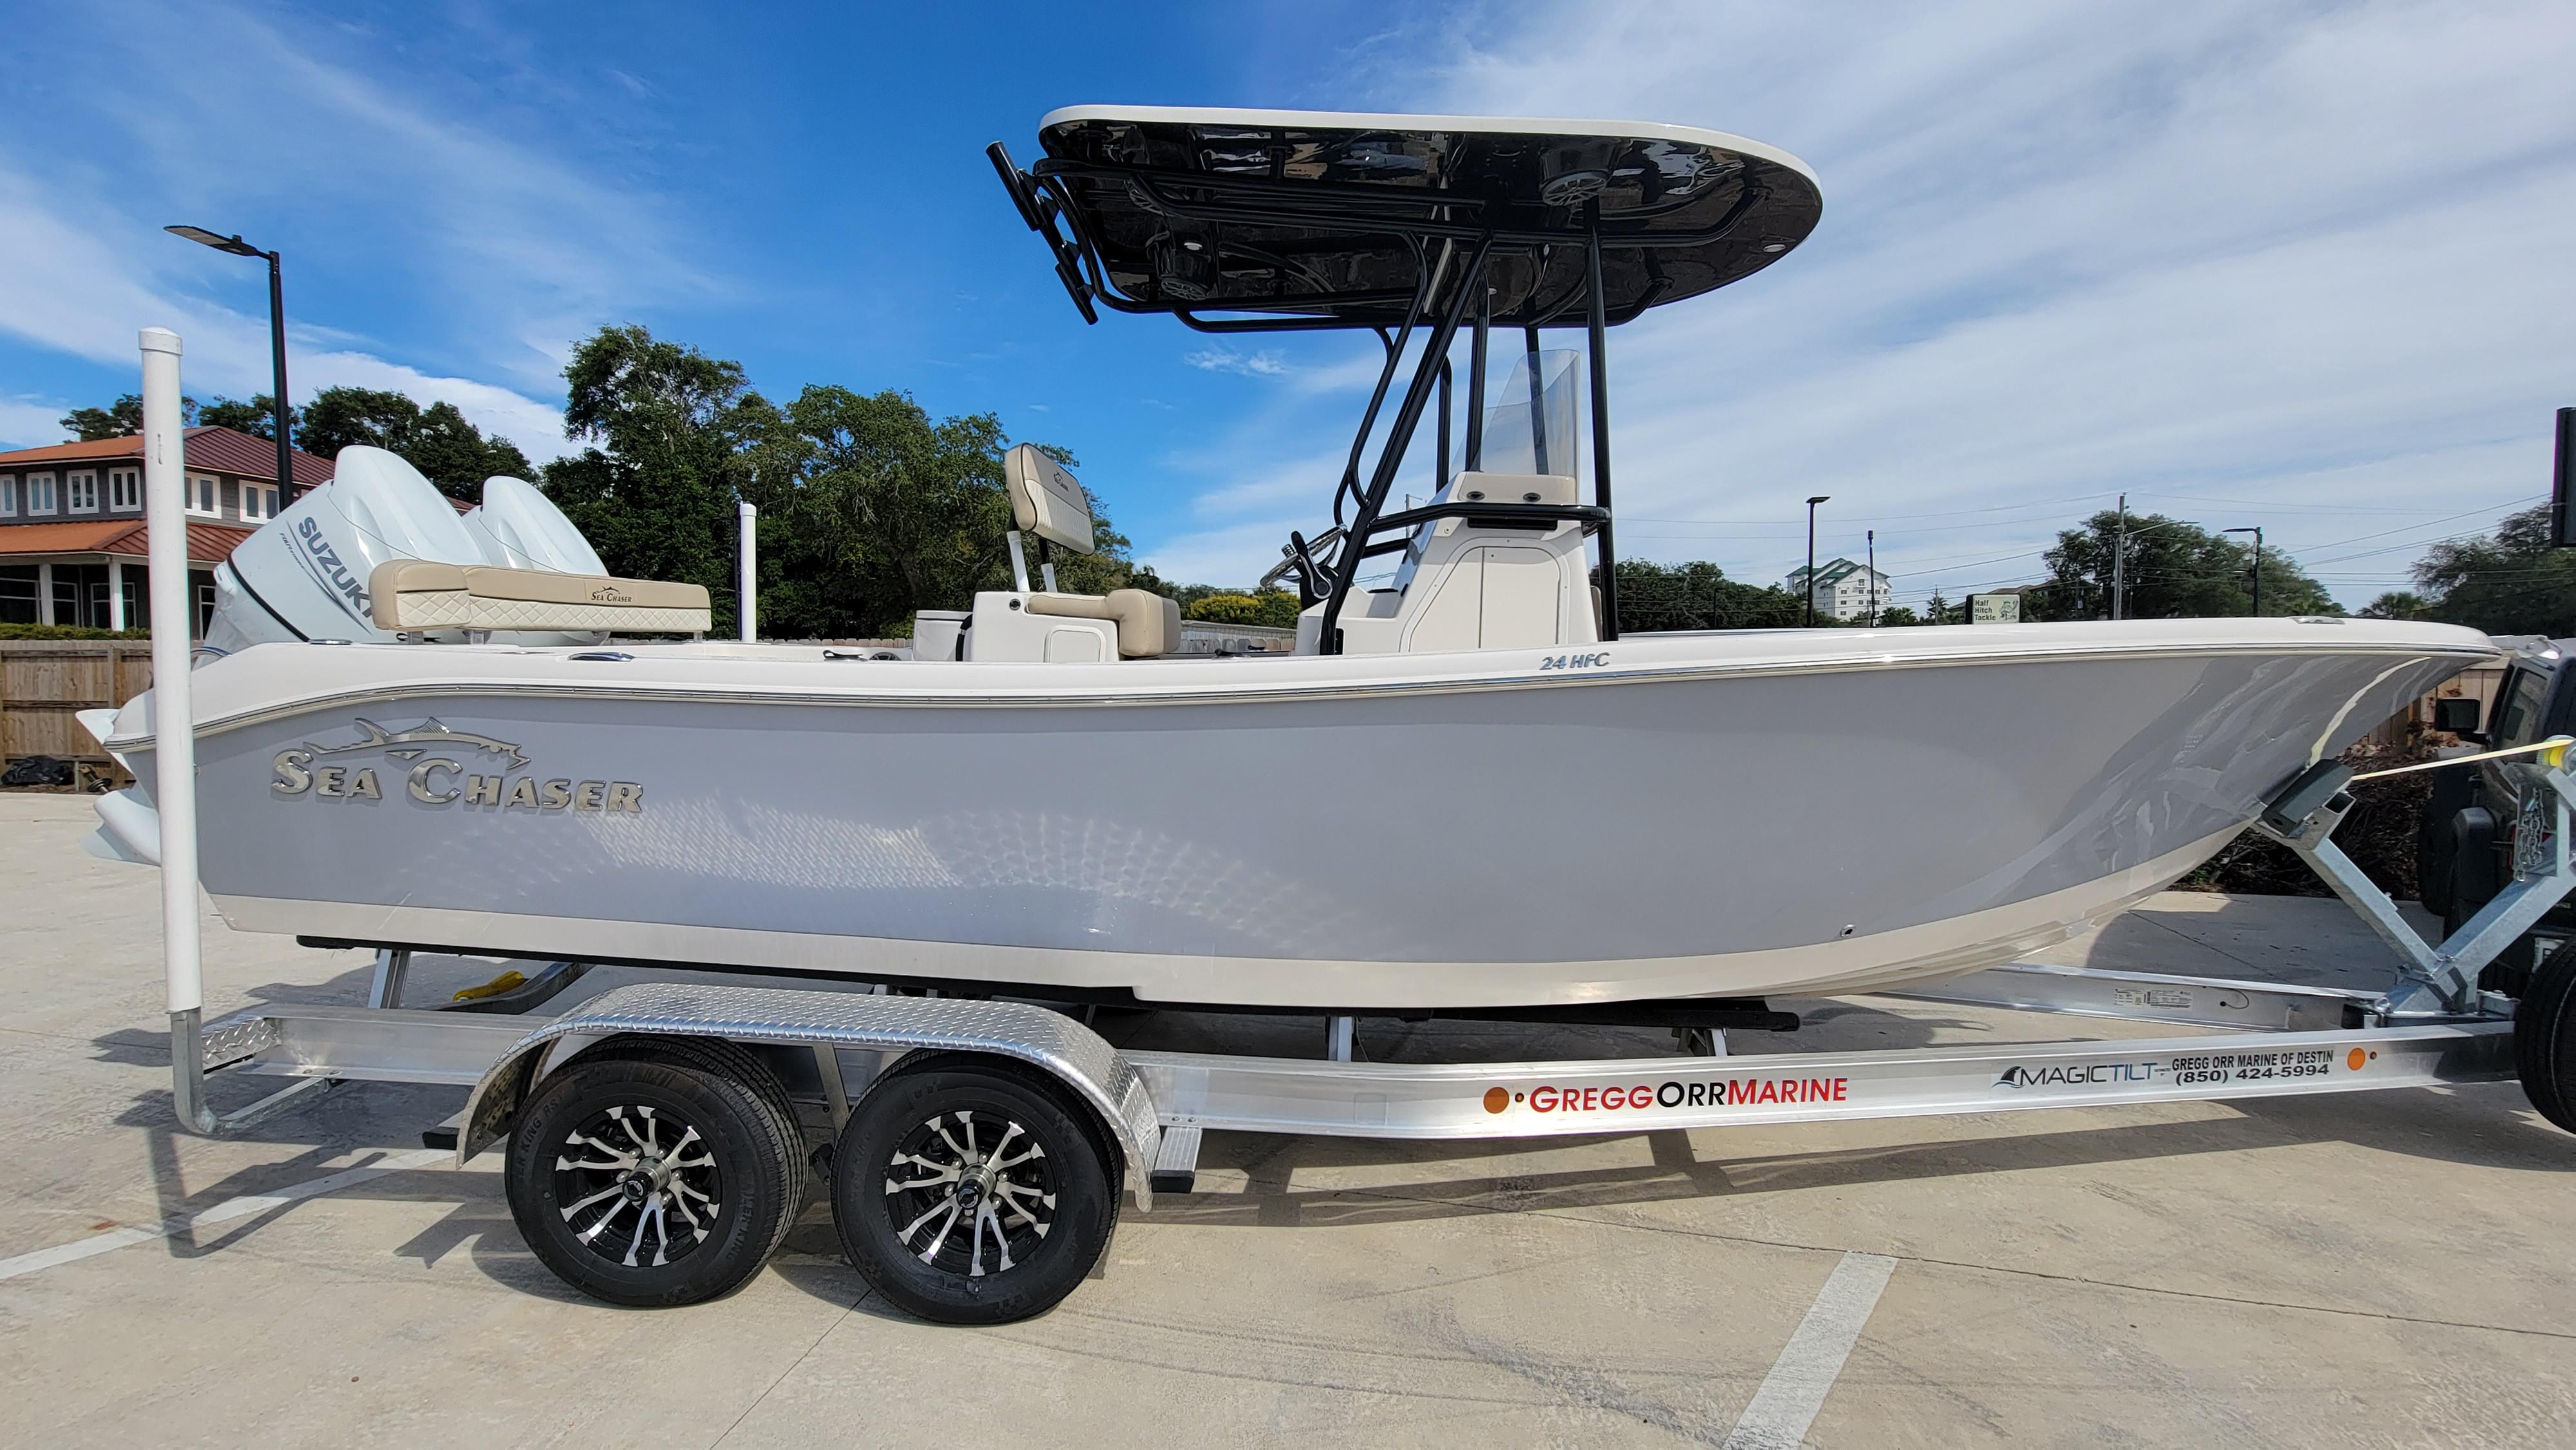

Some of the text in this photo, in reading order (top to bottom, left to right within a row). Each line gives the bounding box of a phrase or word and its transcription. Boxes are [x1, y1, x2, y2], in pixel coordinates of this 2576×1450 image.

[591, 592, 632, 602] SEA CHASER
[1539, 652, 1611, 670] 24 HFC
[271, 748, 644, 813] SEA CHASER
[2172, 1050, 2334, 1071] GREGG ORR MARINE OF DESTIN
[2020, 1062, 2158, 1086] MAGICTILT
[2176, 1069, 2228, 1086] (850)
[2235, 1064, 2329, 1080] 424-5994
